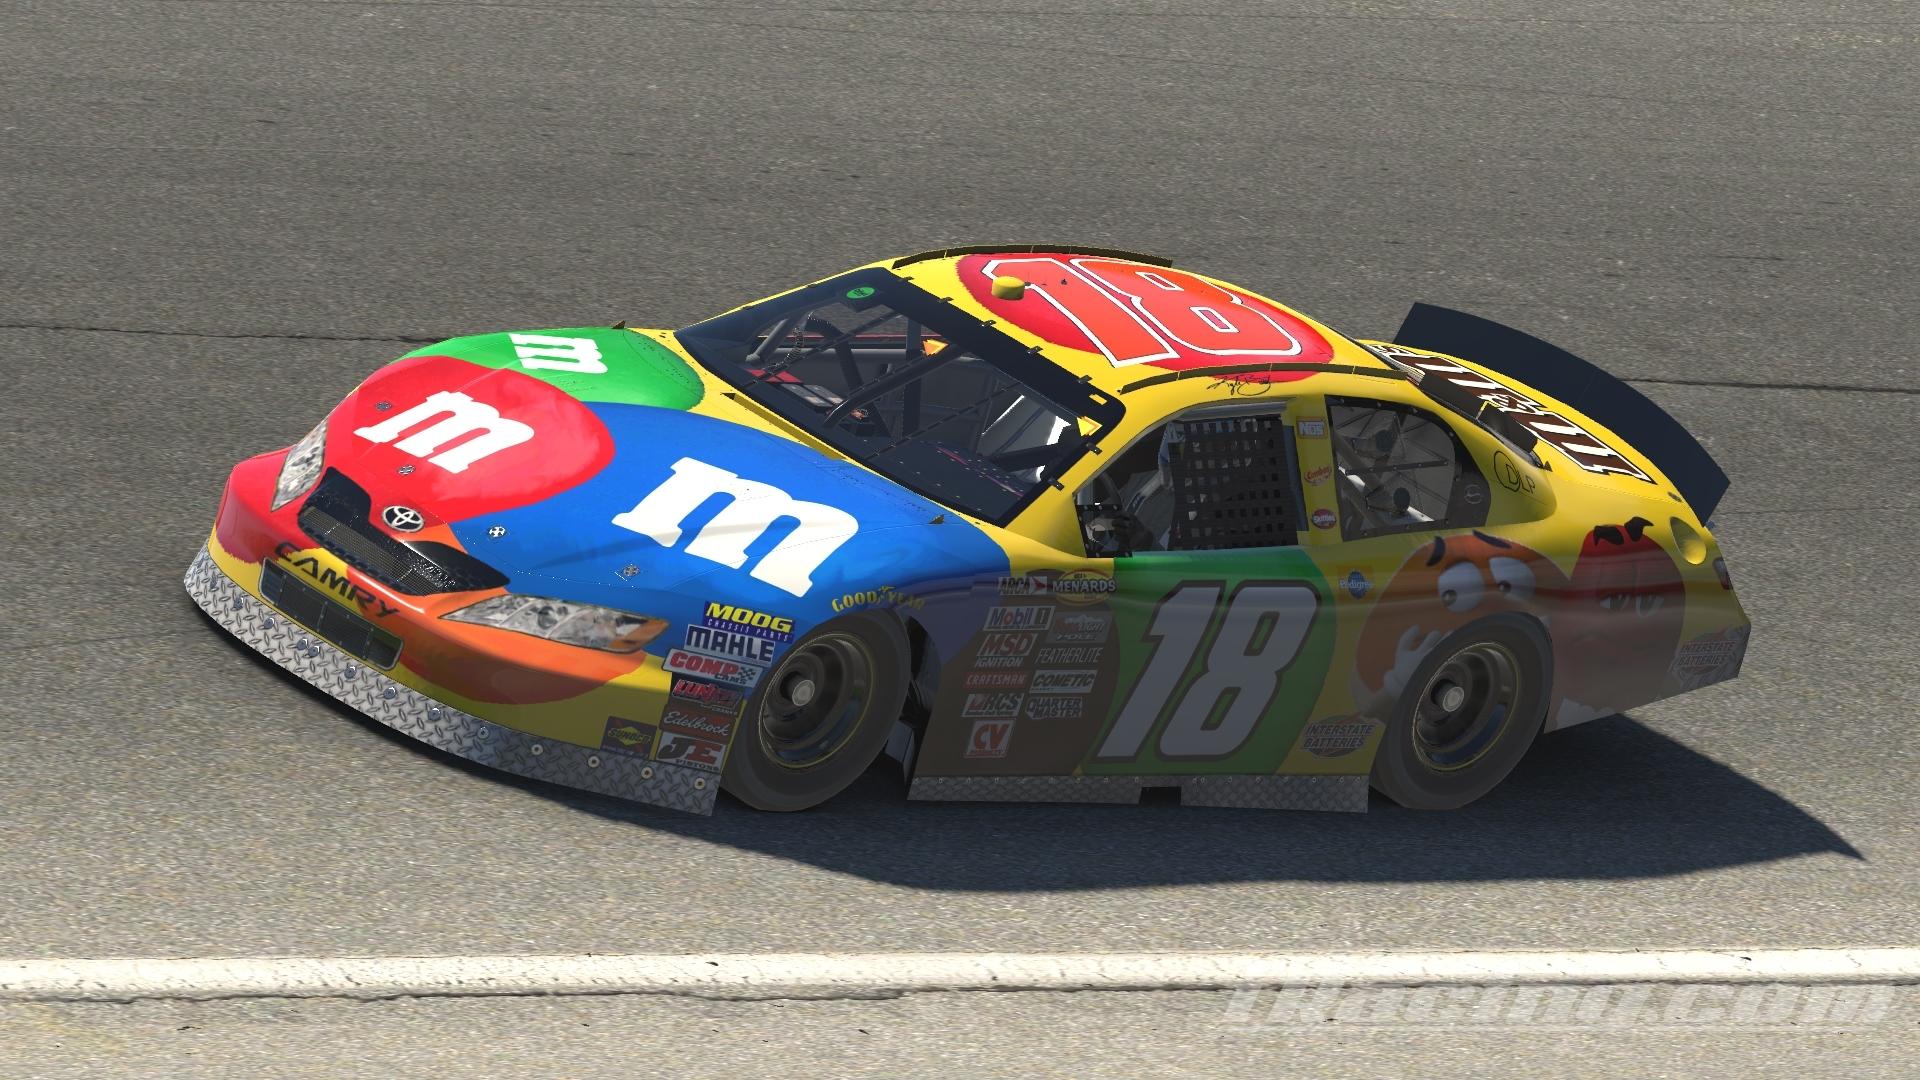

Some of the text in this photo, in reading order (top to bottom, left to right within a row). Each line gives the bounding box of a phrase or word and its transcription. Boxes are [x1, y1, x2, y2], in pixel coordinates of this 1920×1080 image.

[982, 257, 1301, 368] 18
[509, 333, 608, 374] m
[354, 391, 534, 473] m
[612, 458, 858, 597] m
[275, 542, 401, 618] CAMRY
[1052, 579, 1116, 593] MENARDS
[706, 602, 793, 633] MOOG
[990, 608, 1034, 625] Mobil
[708, 619, 789, 642] CHASSIS PARTS
[687, 626, 774, 662] MAHLE
[980, 633, 1033, 655] MSD
[669, 652, 740, 677] COMP
[975, 657, 1023, 668] IGNITION
[1035, 648, 1104, 664] FEATHERLITE
[715, 672, 747, 686] CAMS
[966, 674, 1026, 686] CRAFTSMAN
[1033, 673, 1095, 687] COMETIC
[1098, 580, 1320, 759] 18
[1027, 697, 1081, 712] QUARTER
[664, 711, 729, 736] Edelbrock
[1305, 724, 1375, 735] INTERSTATE
[1304, 736, 1366, 748] BATTERIES
[675, 758, 719, 773] PISTONS
